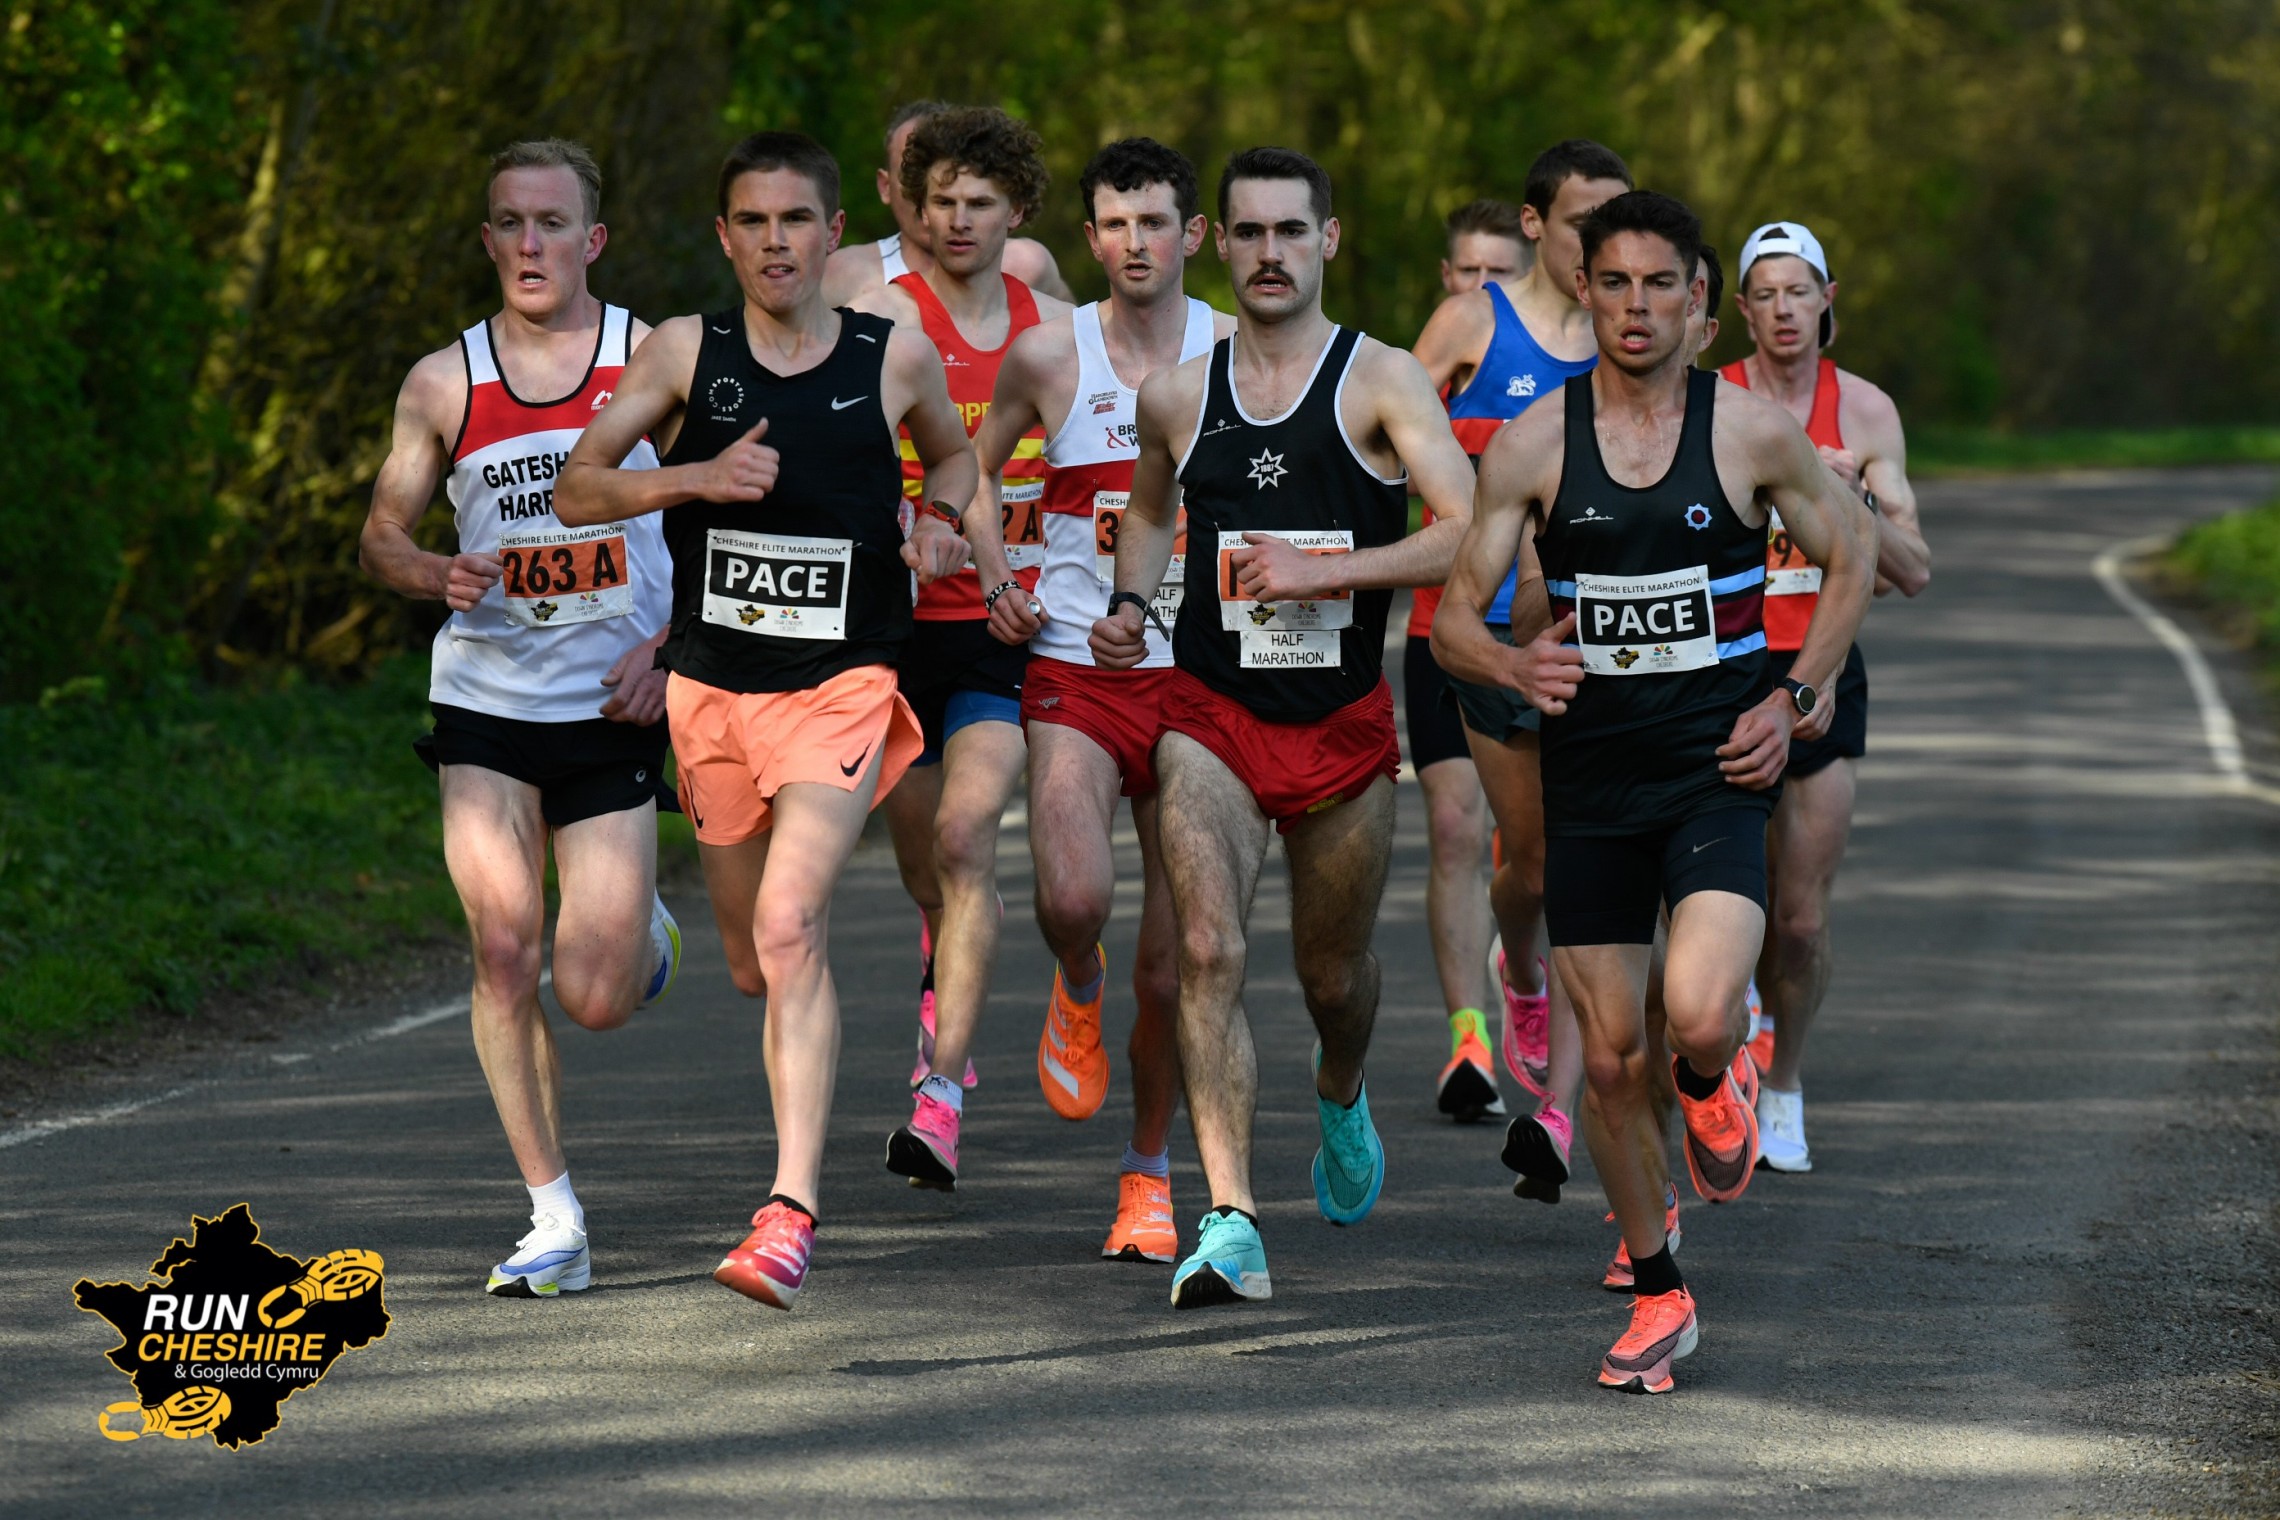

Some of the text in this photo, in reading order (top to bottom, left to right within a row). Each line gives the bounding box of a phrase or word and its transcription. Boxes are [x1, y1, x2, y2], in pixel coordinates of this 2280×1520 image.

[1015, 489, 1042, 499] MARATHON
[1020, 503, 1038, 542] A
[1098, 511, 1119, 553] 3
[501, 526, 622, 546] CHESHIRE ELITE MARATHON
[1293, 537, 1348, 546] MARATHON
[716, 537, 842, 555] CHESHIRE ELITE MARATHON
[503, 542, 619, 595] 263 A
[725, 557, 829, 598] PACE
[1583, 577, 1701, 594] CHESHIRE ELITE MARATHON
[1593, 598, 1696, 637] PACE
[1271, 633, 1304, 647] HALF
[1251, 651, 1325, 665] MARATHON
